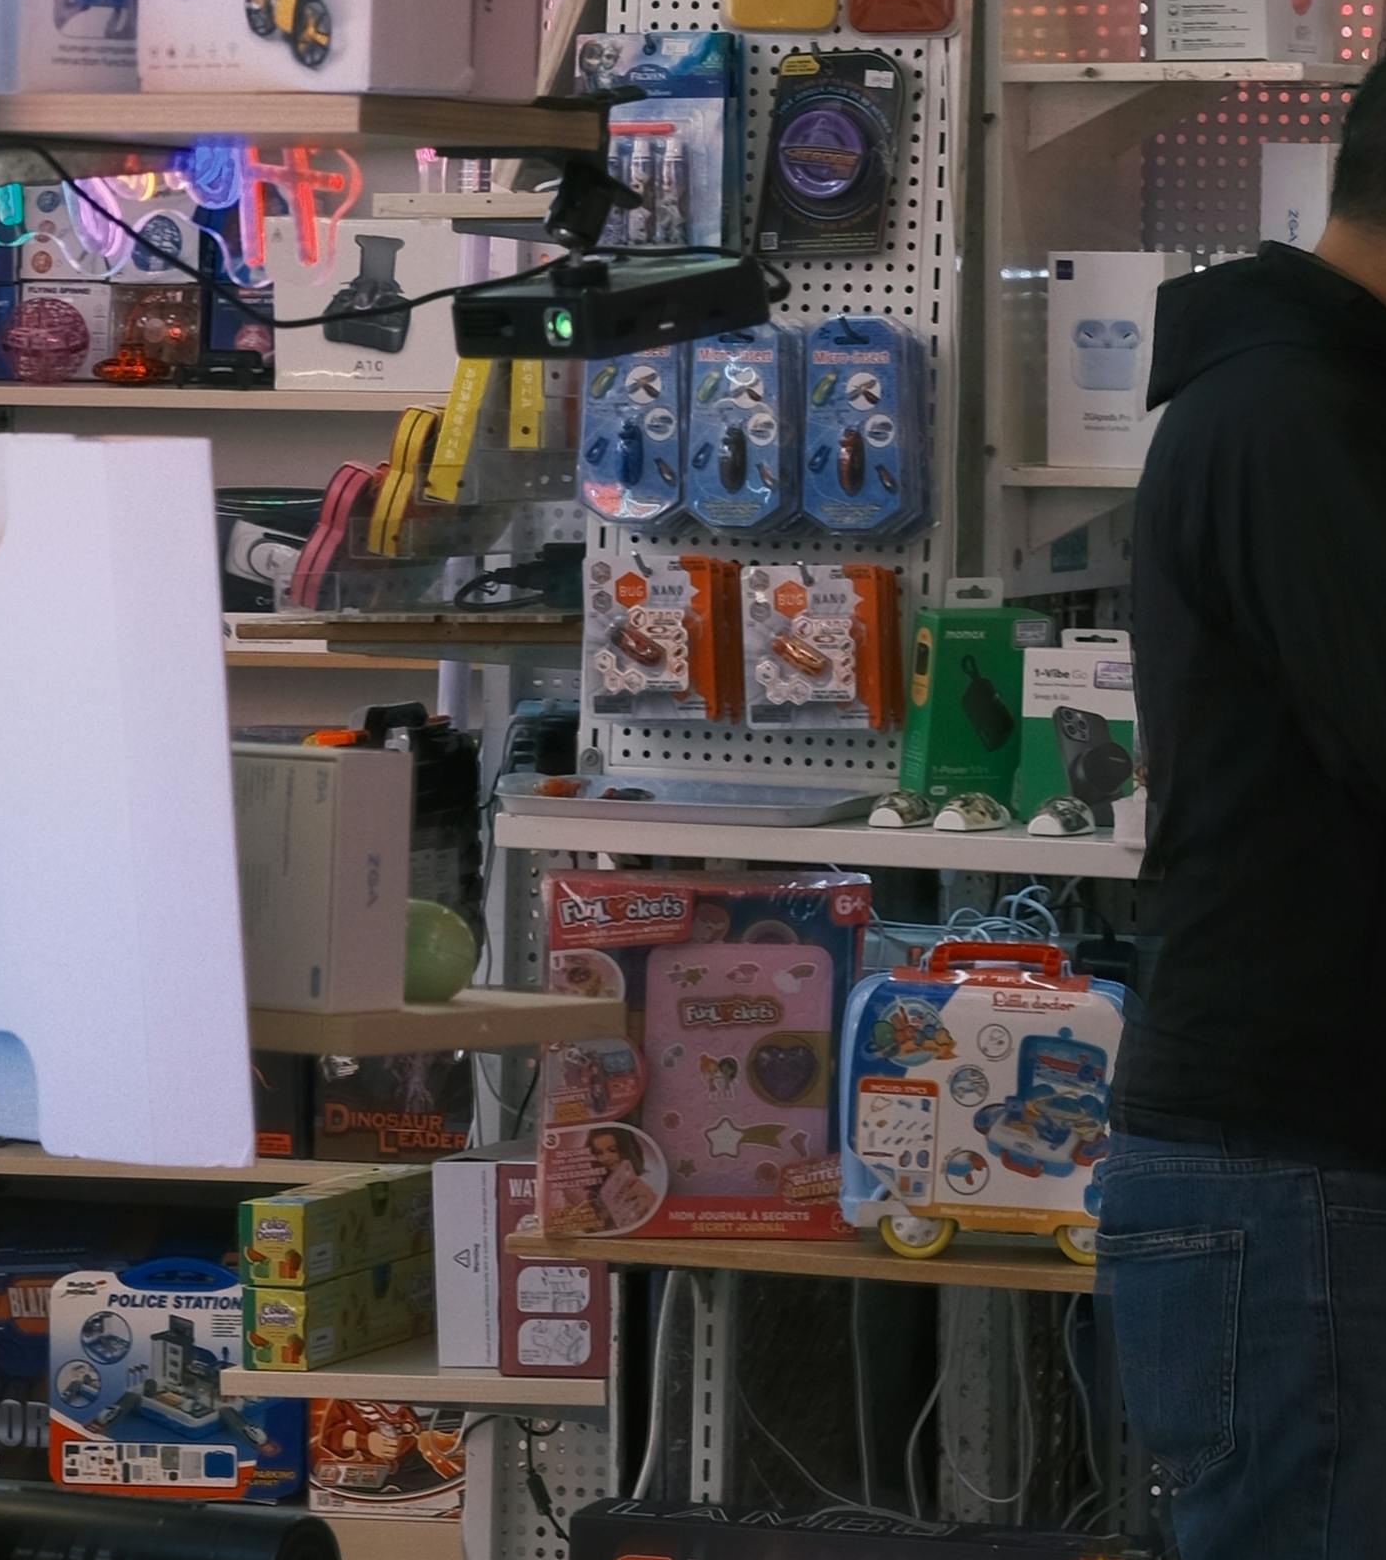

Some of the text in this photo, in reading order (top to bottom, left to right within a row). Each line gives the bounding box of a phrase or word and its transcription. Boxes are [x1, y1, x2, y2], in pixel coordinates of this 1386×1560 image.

[354, 360, 384, 372] A10
[617, 583, 684, 598] BUG NANO
[775, 591, 847, 607] BUG NANO
[834, 894, 864, 916] 6+
[324, 1102, 443, 1134] DINOSAUR
[378, 1127, 468, 1153] LEADER
[697, 1211, 749, 1223] JOURNAL
[761, 1211, 811, 1223] SECRETS
[690, 1222, 788, 1235] SECRET JOURNAL
[108, 1293, 243, 1310] POLICE STATION
